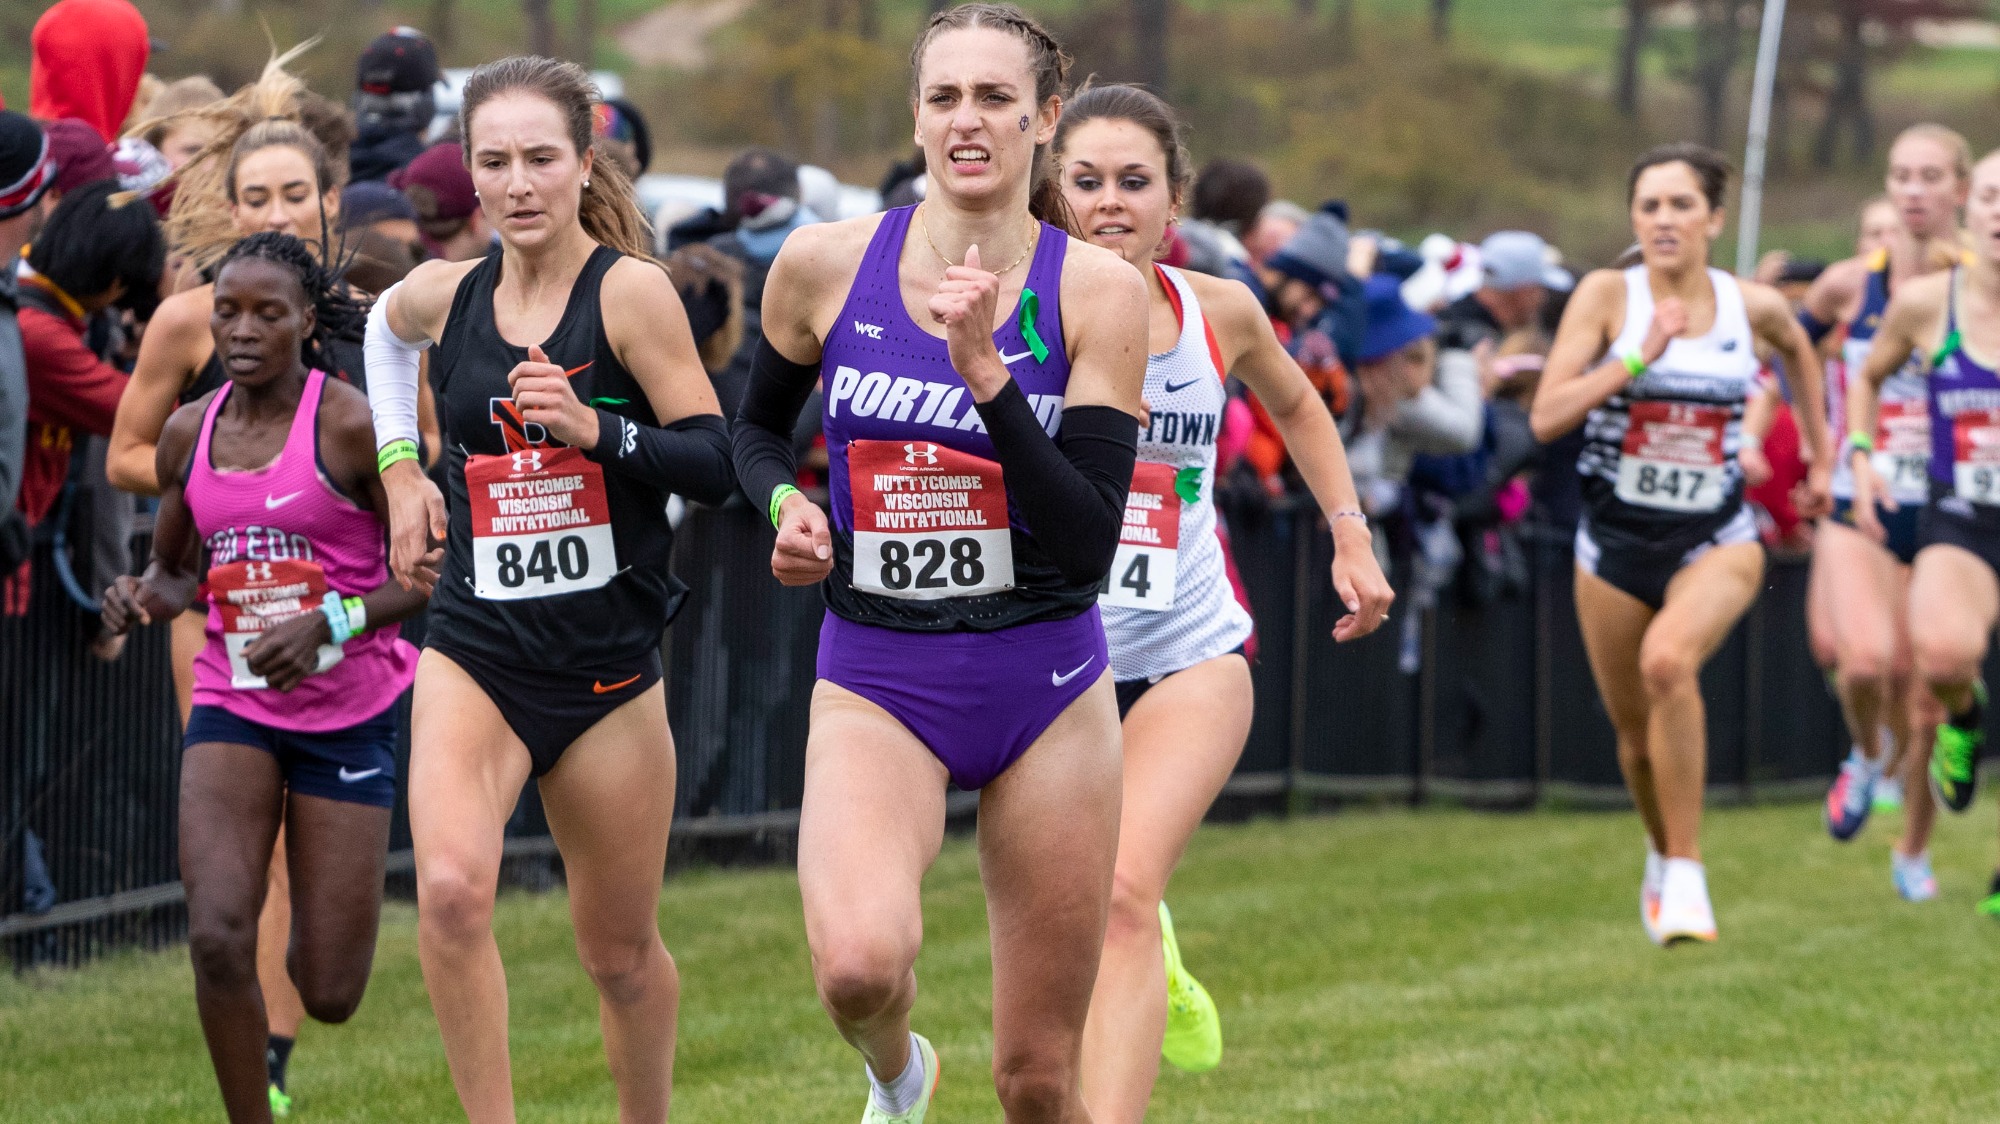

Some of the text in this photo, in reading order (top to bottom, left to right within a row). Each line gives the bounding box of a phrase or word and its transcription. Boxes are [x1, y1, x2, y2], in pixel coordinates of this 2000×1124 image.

[854, 320, 884, 340] WCC
[828, 365, 1065, 439] PORTLAD
[488, 474, 585, 499] NUTTYCOMBE
[873, 474, 983, 492] NUTTYCOMBE
[1637, 465, 1706, 500] 847
[498, 492, 573, 515] WISCONSIN
[883, 492, 969, 510] WISCONSIN
[491, 508, 590, 533] INVITATIONAL
[875, 509, 988, 529] INVITATIONAL
[496, 535, 590, 588] 840
[880, 537, 985, 590] 828
